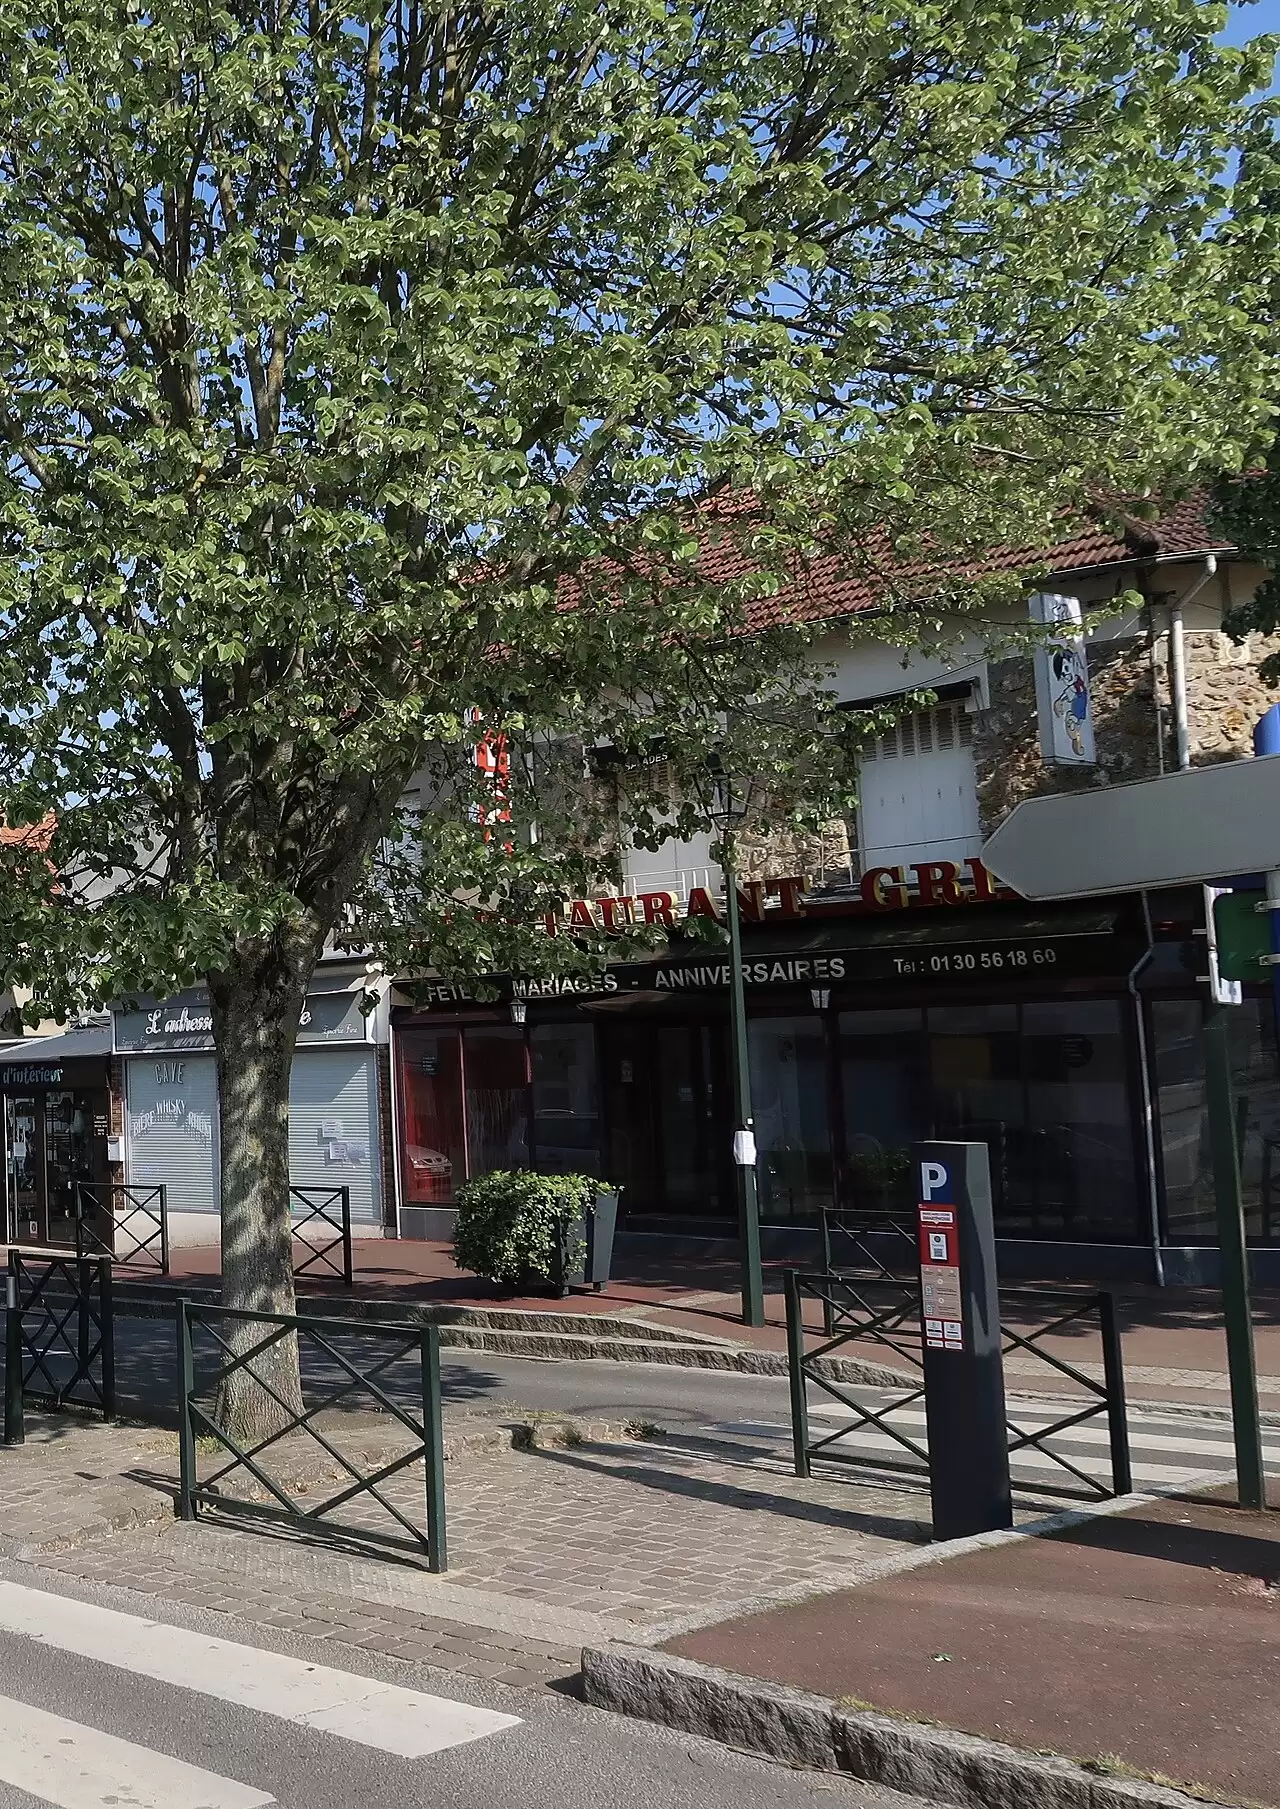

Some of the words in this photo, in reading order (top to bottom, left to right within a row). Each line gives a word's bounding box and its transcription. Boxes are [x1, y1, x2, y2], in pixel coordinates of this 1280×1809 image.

[860, 857, 998, 912] GRI
[511, 973, 618, 997] MARIAGES
[655, 957, 846, 988] ANNIVERSAIRES
[154, 1062, 185, 1084] CAVE
[156, 1098, 186, 1115] WHISKY
[920, 1162, 947, 1201] P
